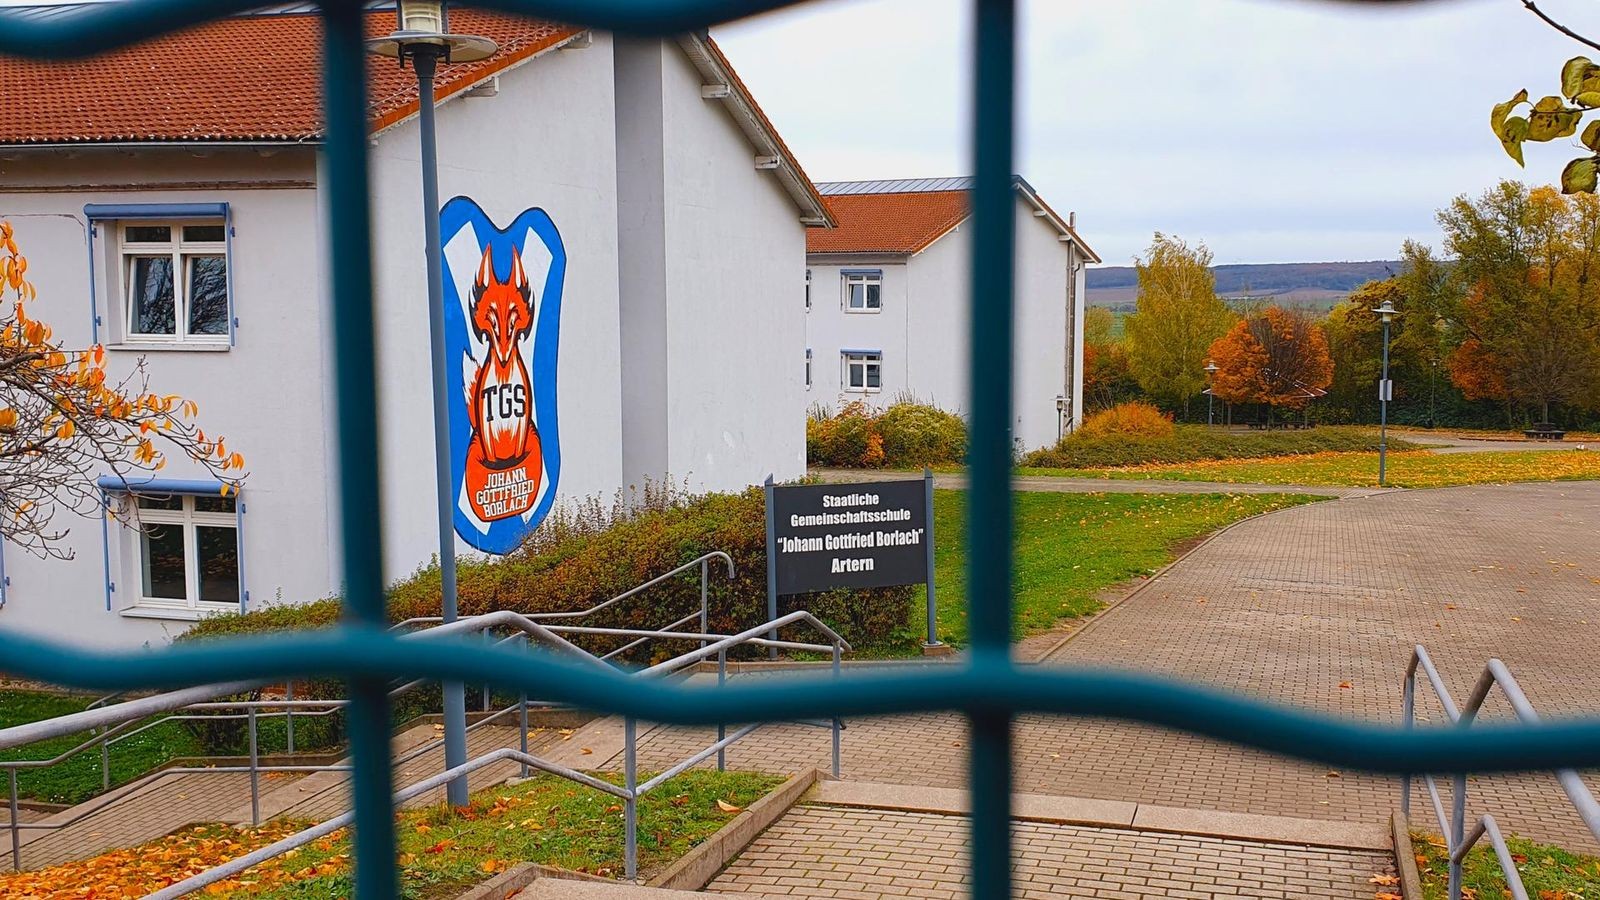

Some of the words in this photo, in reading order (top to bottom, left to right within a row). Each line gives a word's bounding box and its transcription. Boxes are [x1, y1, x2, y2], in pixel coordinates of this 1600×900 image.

[481, 383, 526, 422] TGS
[484, 467, 527, 489] JOHANN
[476, 480, 534, 505] GOTTFRIED
[823, 493, 879, 508] Staatliche
[483, 495, 529, 518] BORLACH
[790, 508, 911, 527] Gemeinschaftsschule
[777, 535, 823, 553] “Johann
[825, 531, 874, 551] Gottfried
[876, 528, 924, 547] Borlach”
[831, 558, 874, 574] Artern
